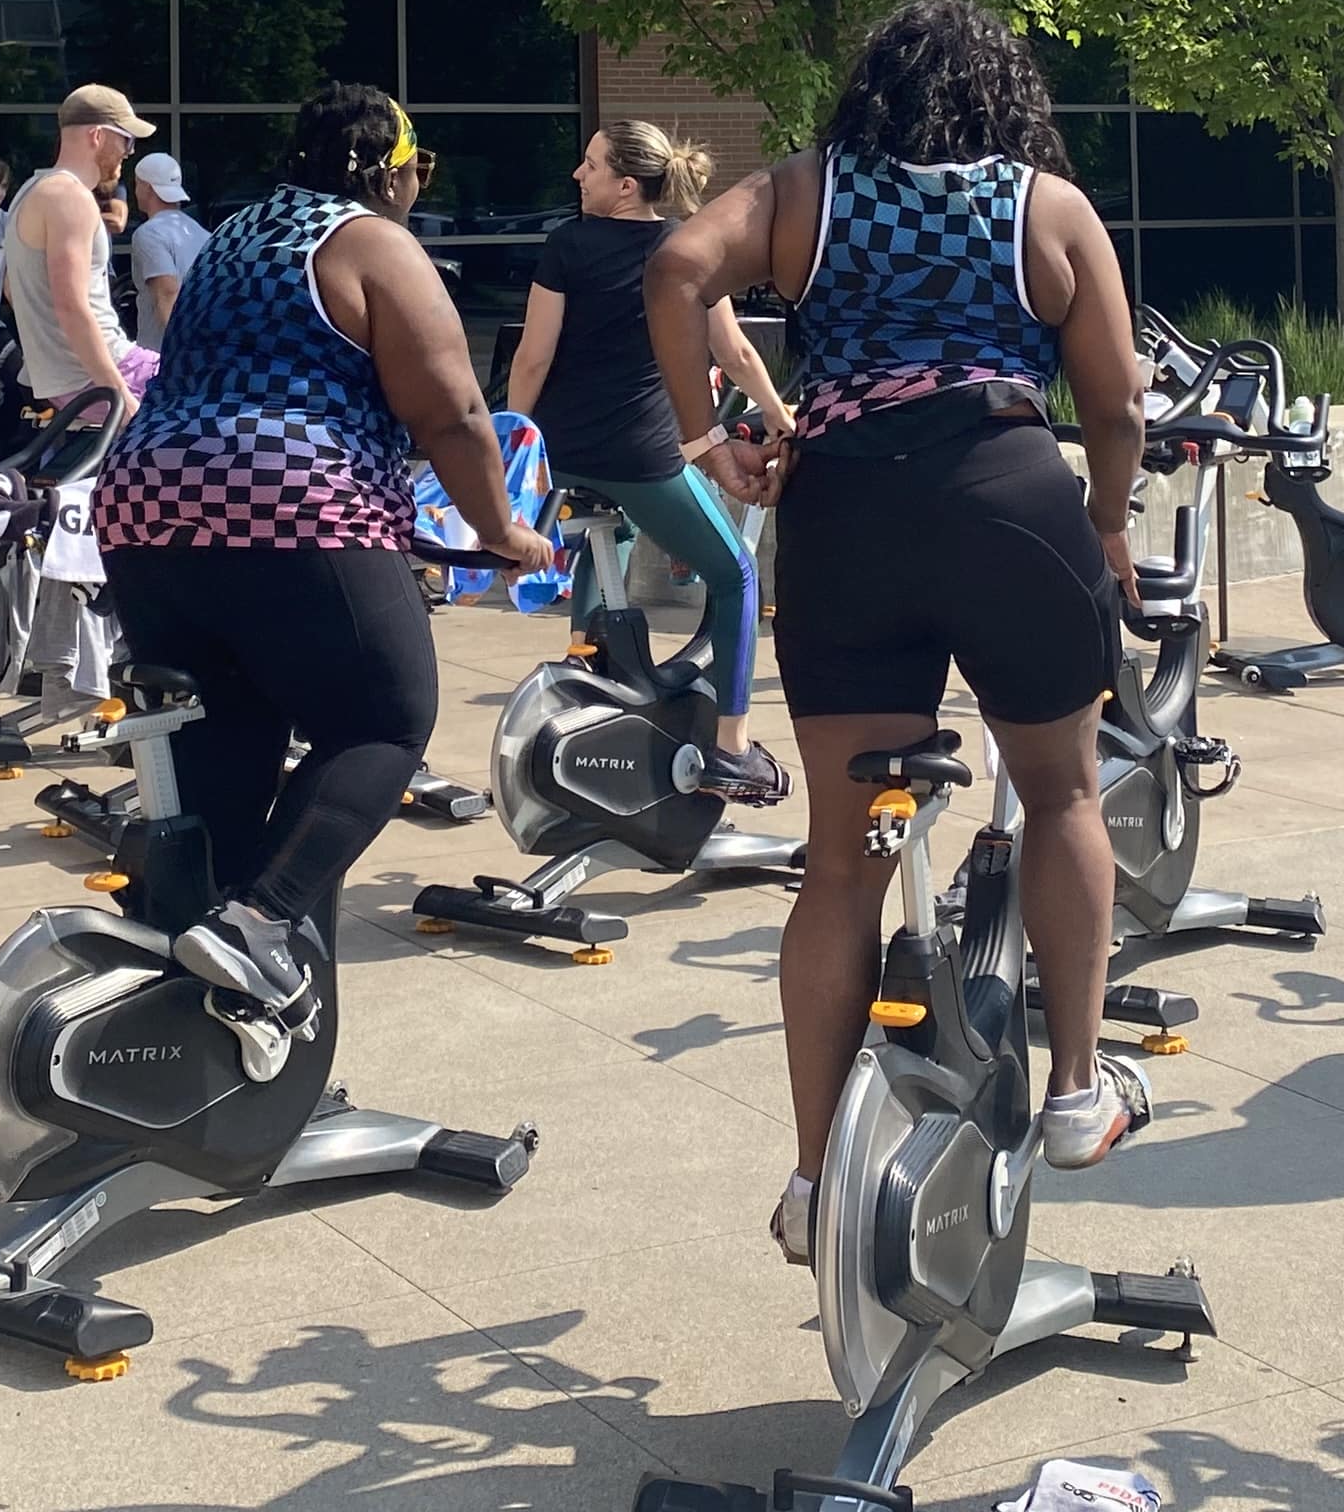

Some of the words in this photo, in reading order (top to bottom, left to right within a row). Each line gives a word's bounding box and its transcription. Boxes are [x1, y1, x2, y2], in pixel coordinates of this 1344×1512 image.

[575, 756, 636, 771] MATRIX
[1107, 815, 1144, 829] MATRIX
[88, 1045, 183, 1065] MATRIX
[926, 1203, 969, 1238] MATRIX
